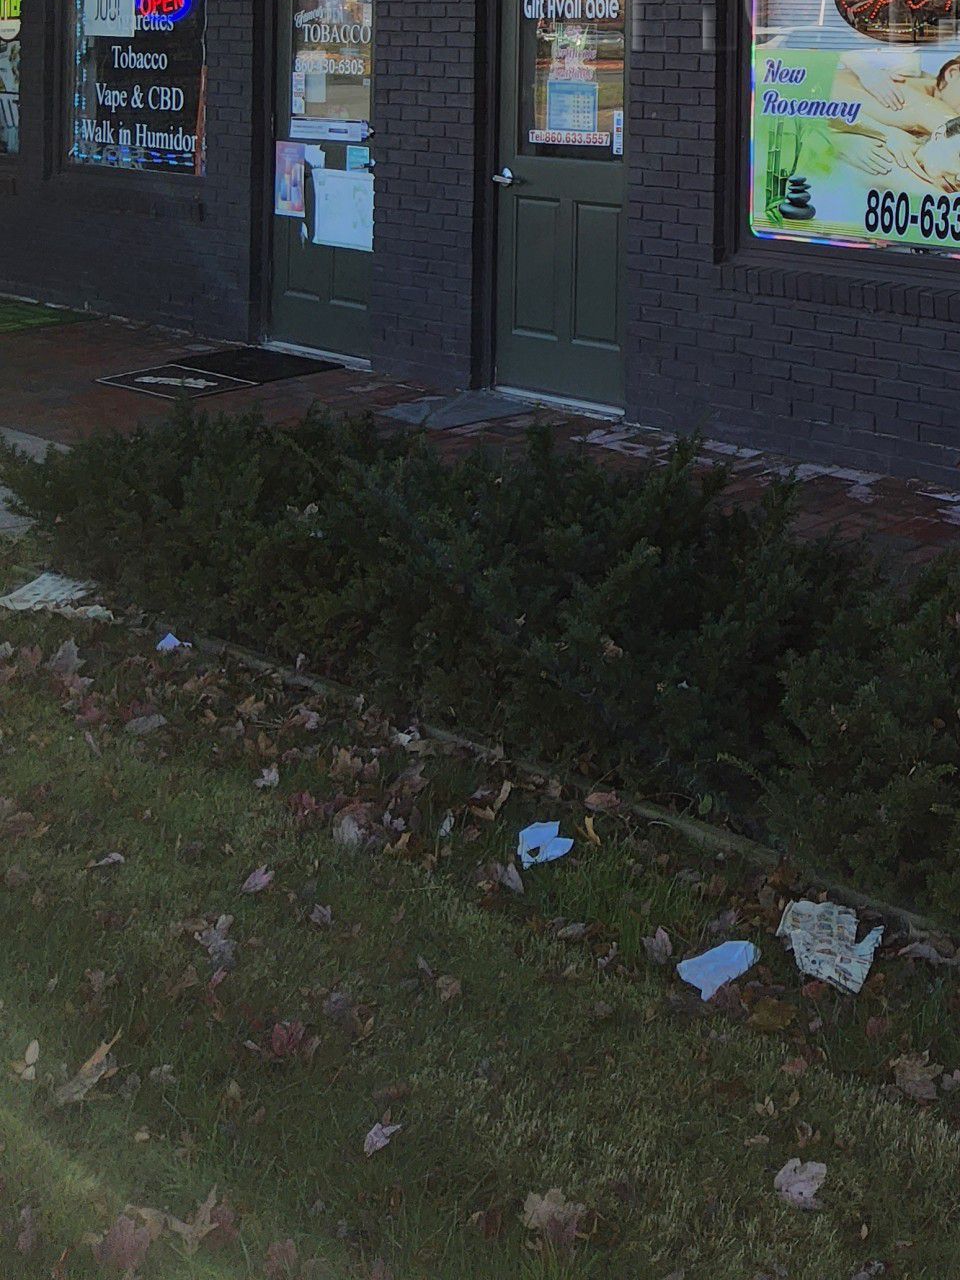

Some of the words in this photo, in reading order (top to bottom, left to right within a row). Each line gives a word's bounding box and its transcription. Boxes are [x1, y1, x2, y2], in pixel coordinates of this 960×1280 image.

[302, 24, 372, 45] TOBACCO
[111, 45, 168, 70] Tobacco
[763, 59, 807, 84] New
[95, 83, 127, 114] Vape
[131, 88, 144, 109] &
[148, 86, 184, 111] CBD
[761, 89, 862, 125] Rosemary
[83, 119, 115, 144] Walk
[118, 122, 131, 145] in
[136, 124, 198, 153] Humidor
